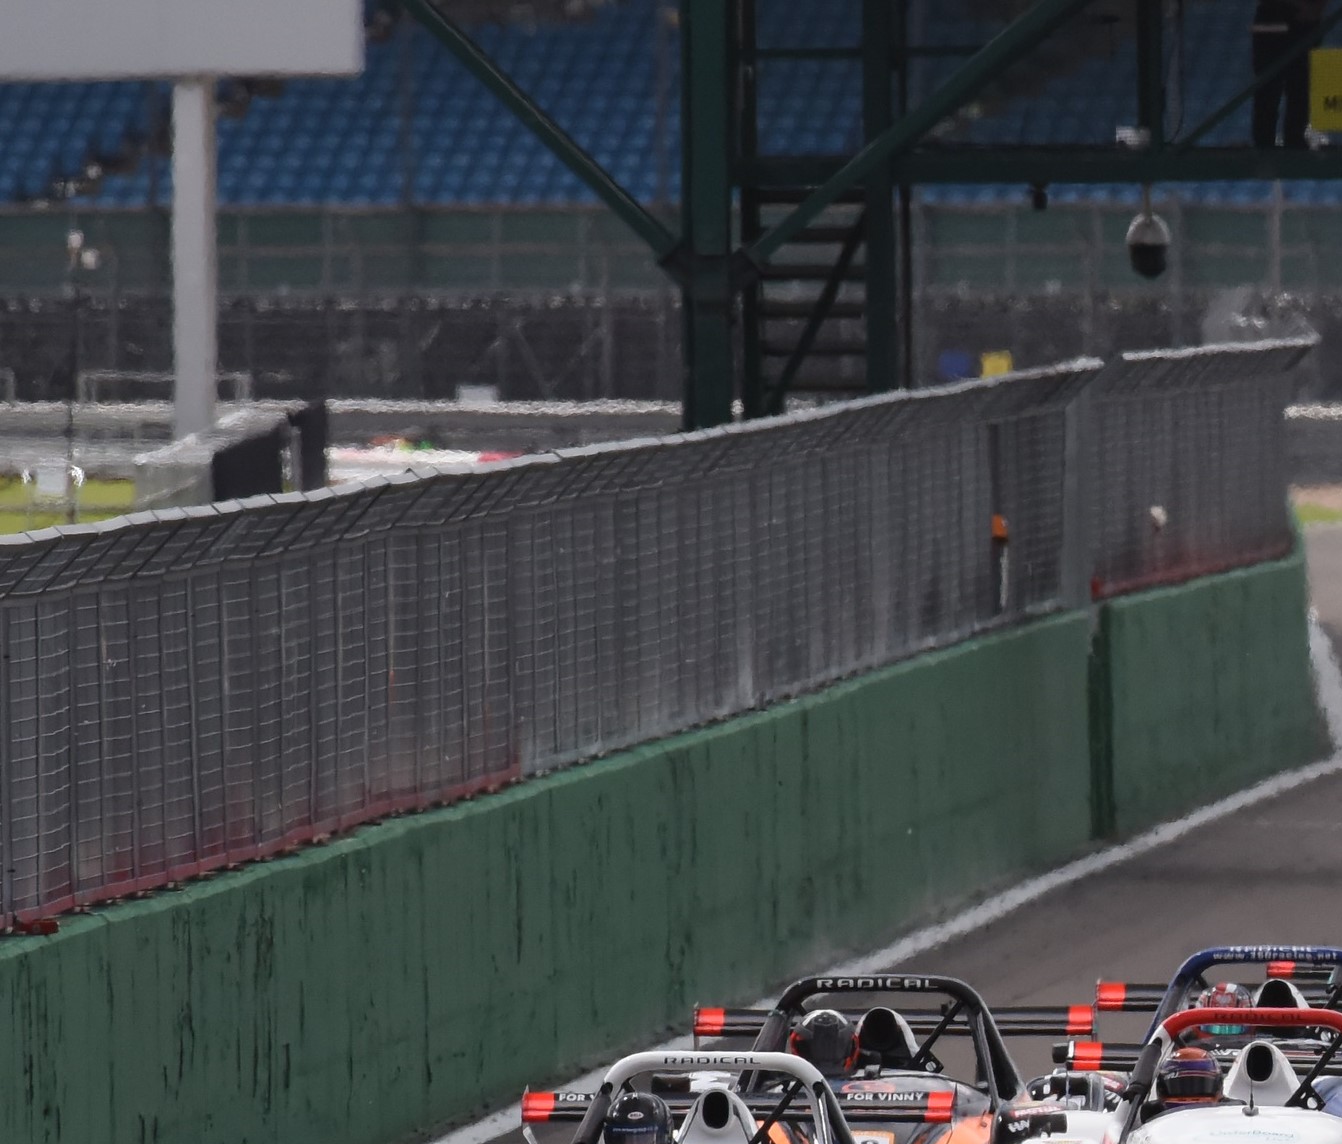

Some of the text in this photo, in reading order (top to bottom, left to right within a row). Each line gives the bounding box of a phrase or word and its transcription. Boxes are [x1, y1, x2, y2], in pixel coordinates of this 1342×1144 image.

[815, 978, 939, 989] RADICAL
[663, 1056, 761, 1065] RADICAL
[558, 1093, 585, 1102] FOR
[846, 1092, 924, 1101] FOR VINNY
